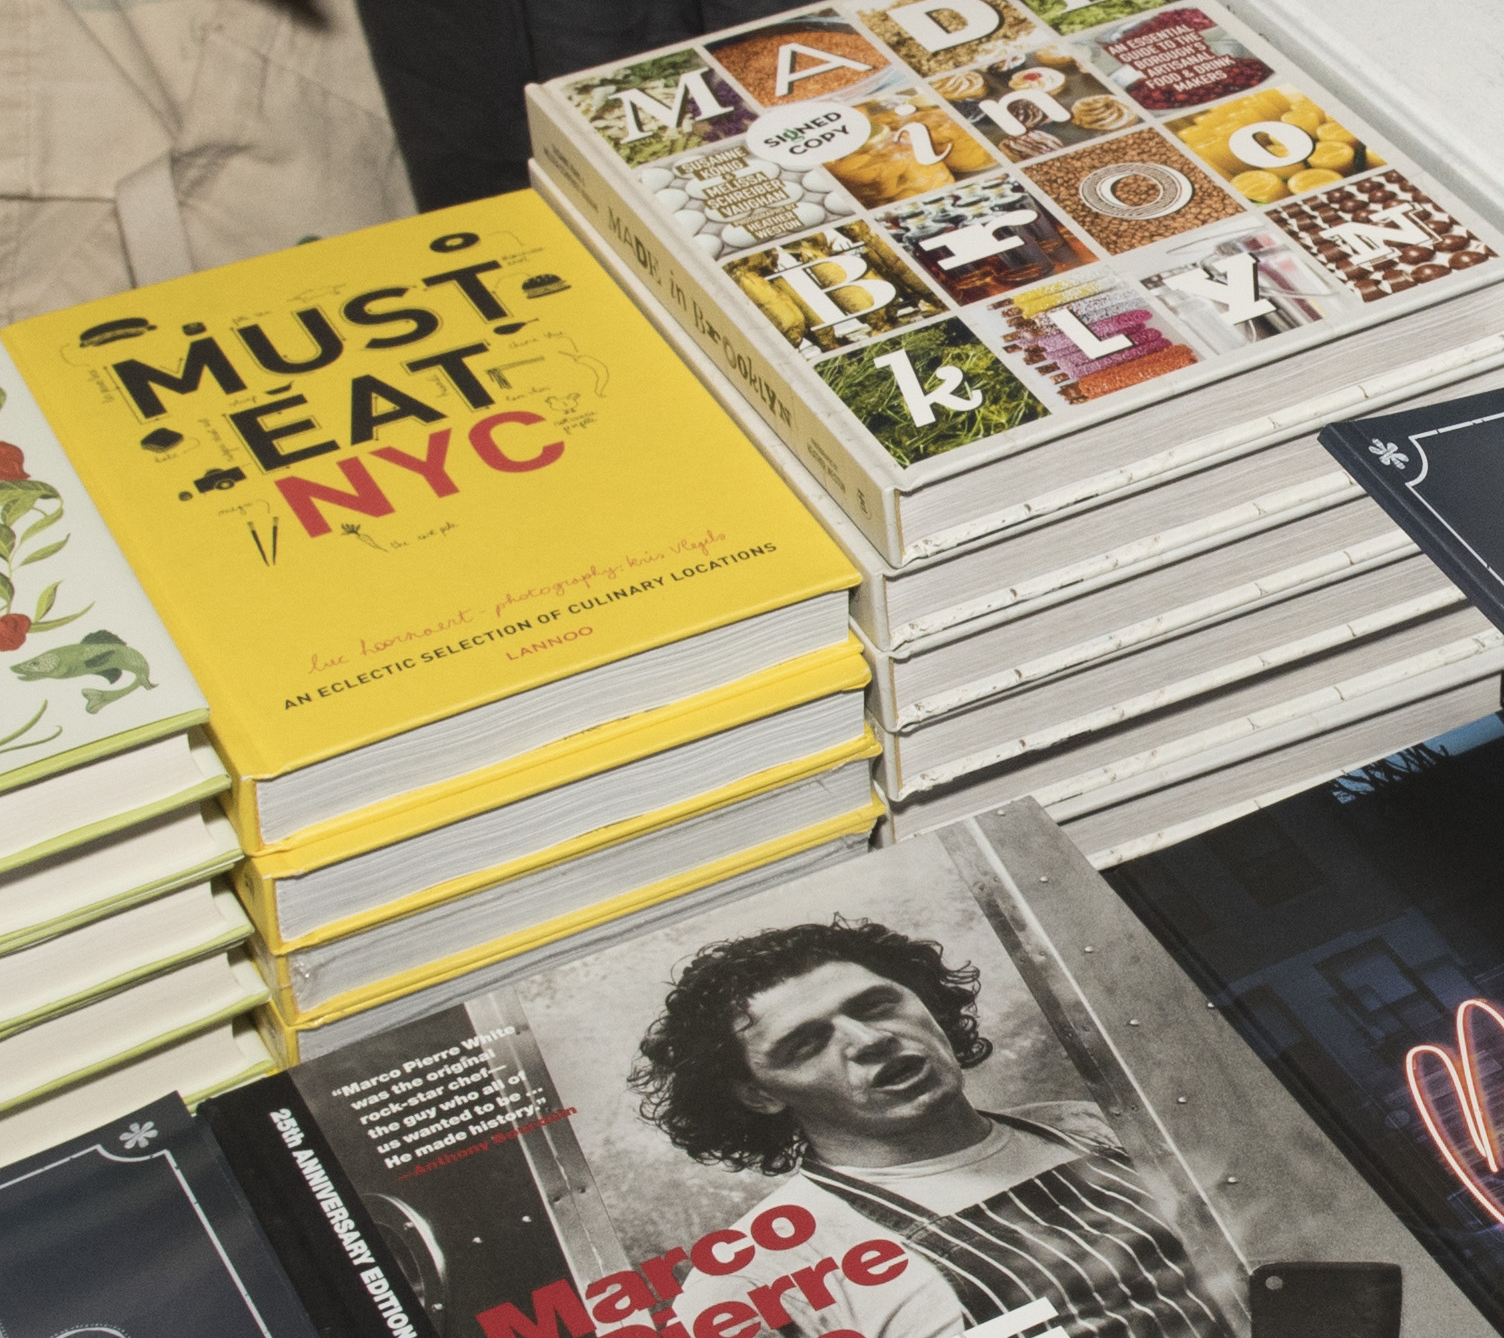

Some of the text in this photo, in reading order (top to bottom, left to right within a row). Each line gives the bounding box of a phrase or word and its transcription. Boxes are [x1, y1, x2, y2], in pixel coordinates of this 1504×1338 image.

[764, 111, 842, 148] SIGNED
[789, 125, 850, 155] COPY
[707, 172, 767, 197] MELISSA
[707, 180, 784, 209] SCHREIBER
[721, 191, 788, 217] VAUGHAN
[112, 261, 515, 420] MUST
[228, 342, 506, 472] EAT
[275, 411, 566, 539] NYC
[283, 542, 778, 712] AN ECLECTIC SELECTION OF CULINARY LOCATIONS
[506, 626, 594, 662] LANNOO
[402, 1046, 460, 1073] Pierre
[460, 1025, 516, 1050] White
[269, 1108, 304, 1149] 25th
[294, 1147, 375, 1267] ANNIVERSARY
